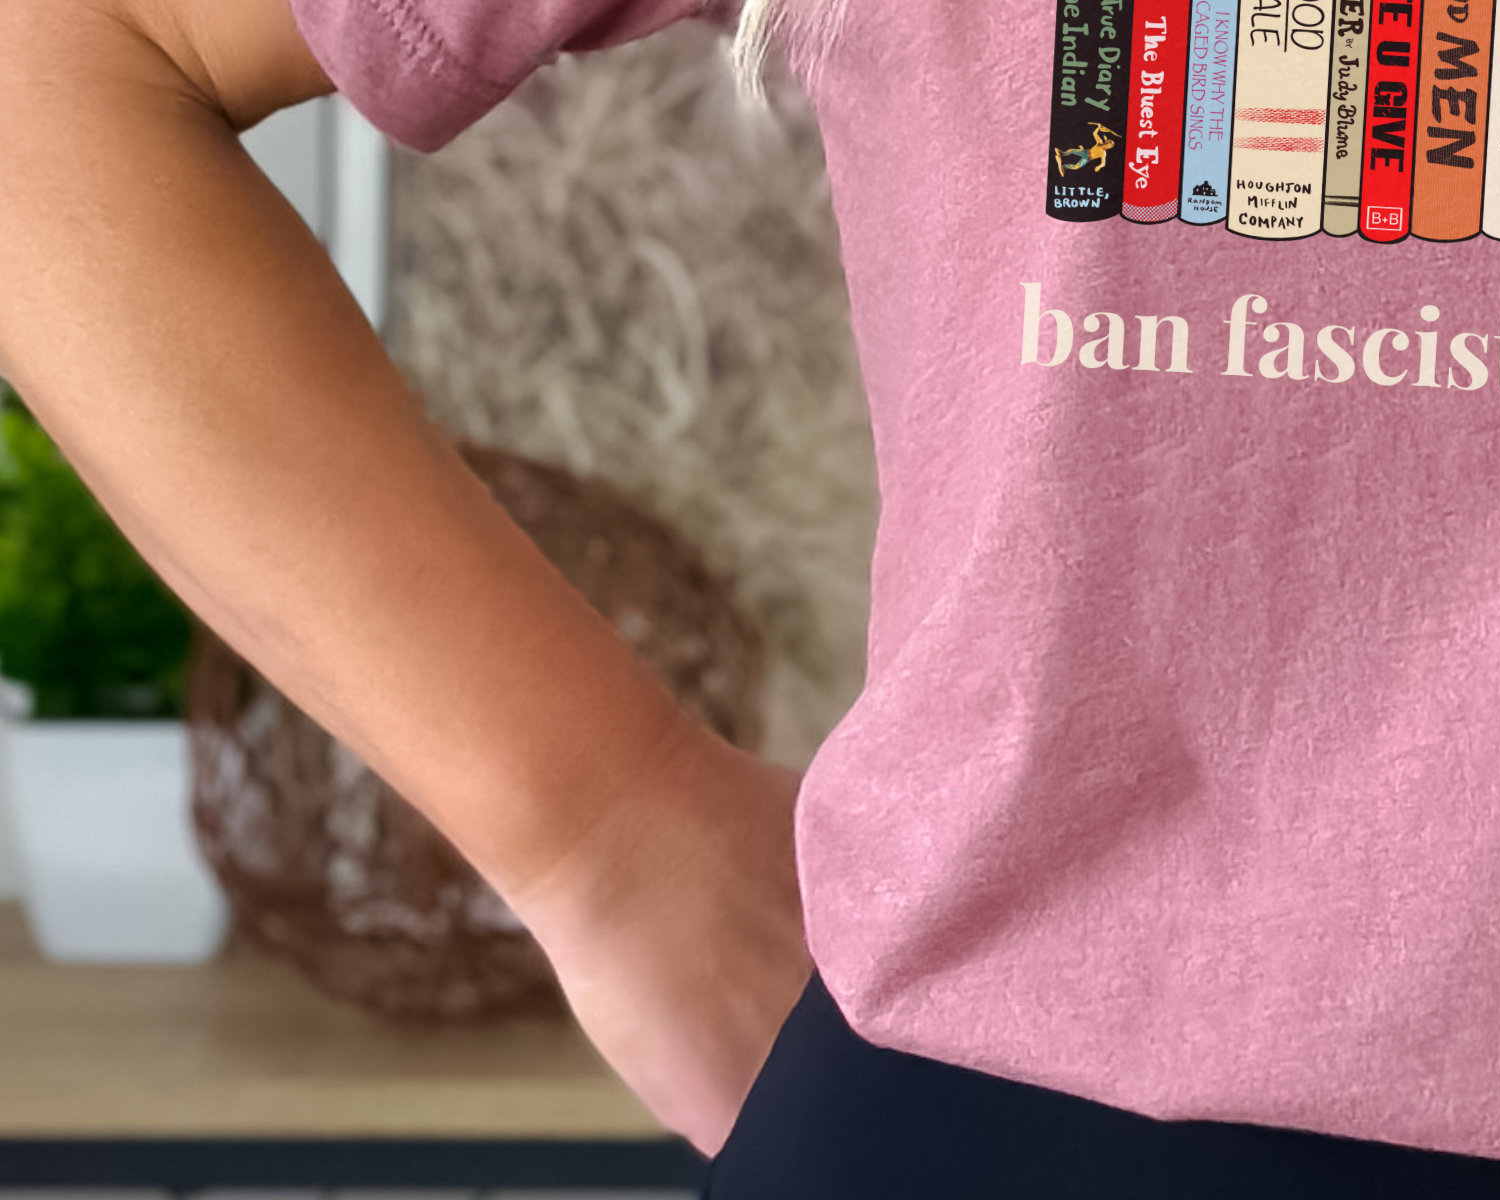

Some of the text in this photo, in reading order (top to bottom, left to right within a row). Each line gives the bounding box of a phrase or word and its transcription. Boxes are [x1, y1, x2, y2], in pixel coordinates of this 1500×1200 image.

[1061, 23, 1089, 107] Indian
[1213, 19, 1230, 67] KNOW
[1377, 41, 1411, 67] U
[1085, 47, 1121, 111] Diary
[1188, 0, 1211, 150] CAGED BIRD SINGS
[1210, 70, 1226, 105] WHY
[1332, 55, 1359, 101] Judy
[1129, 16, 1167, 189] The Bluest Eye
[1426, 31, 1480, 169] MEN
[1208, 108, 1224, 141] THE
[1336, 104, 1357, 160] Blume
[1370, 81, 1408, 172] GIVE
[1054, 186, 1110, 199] LITTLE,
[1054, 198, 1101, 209] BROWN
[1236, 179, 1311, 194] HOUGHTON
[1248, 196, 1297, 210] MIFFLIN
[1239, 212, 1304, 229] COMPANY
[1371, 212, 1399, 226] B+B
[1019, 282, 1193, 375] ban
